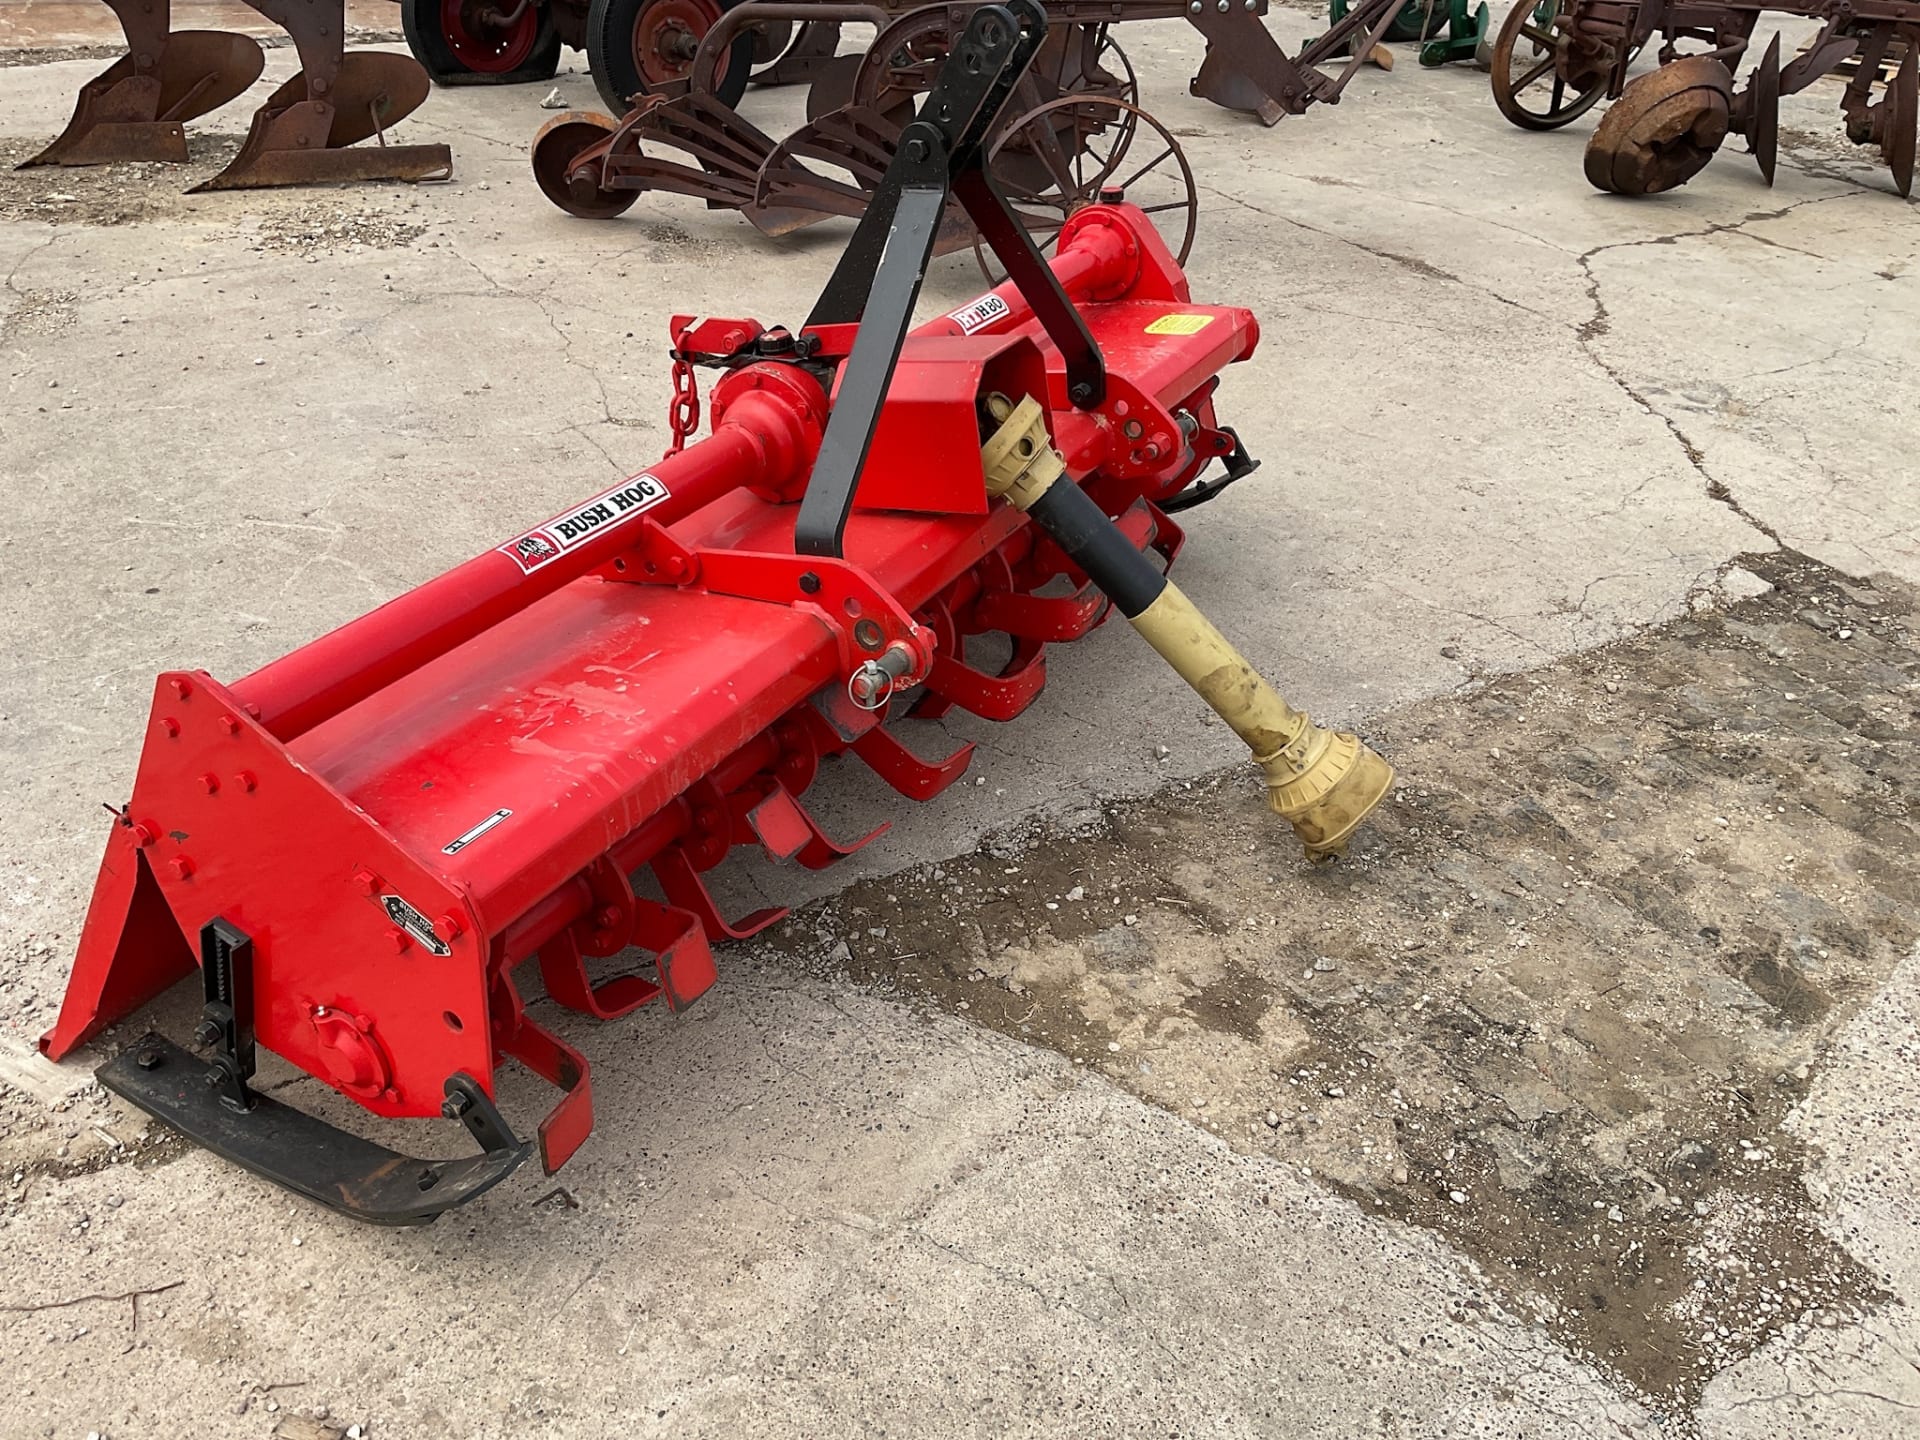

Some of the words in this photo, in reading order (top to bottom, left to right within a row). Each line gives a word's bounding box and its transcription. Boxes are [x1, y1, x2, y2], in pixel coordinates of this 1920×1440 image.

[554, 503, 615, 540] BUSH
[609, 481, 656, 512] HOG
[399, 901, 418, 919] BUSH
